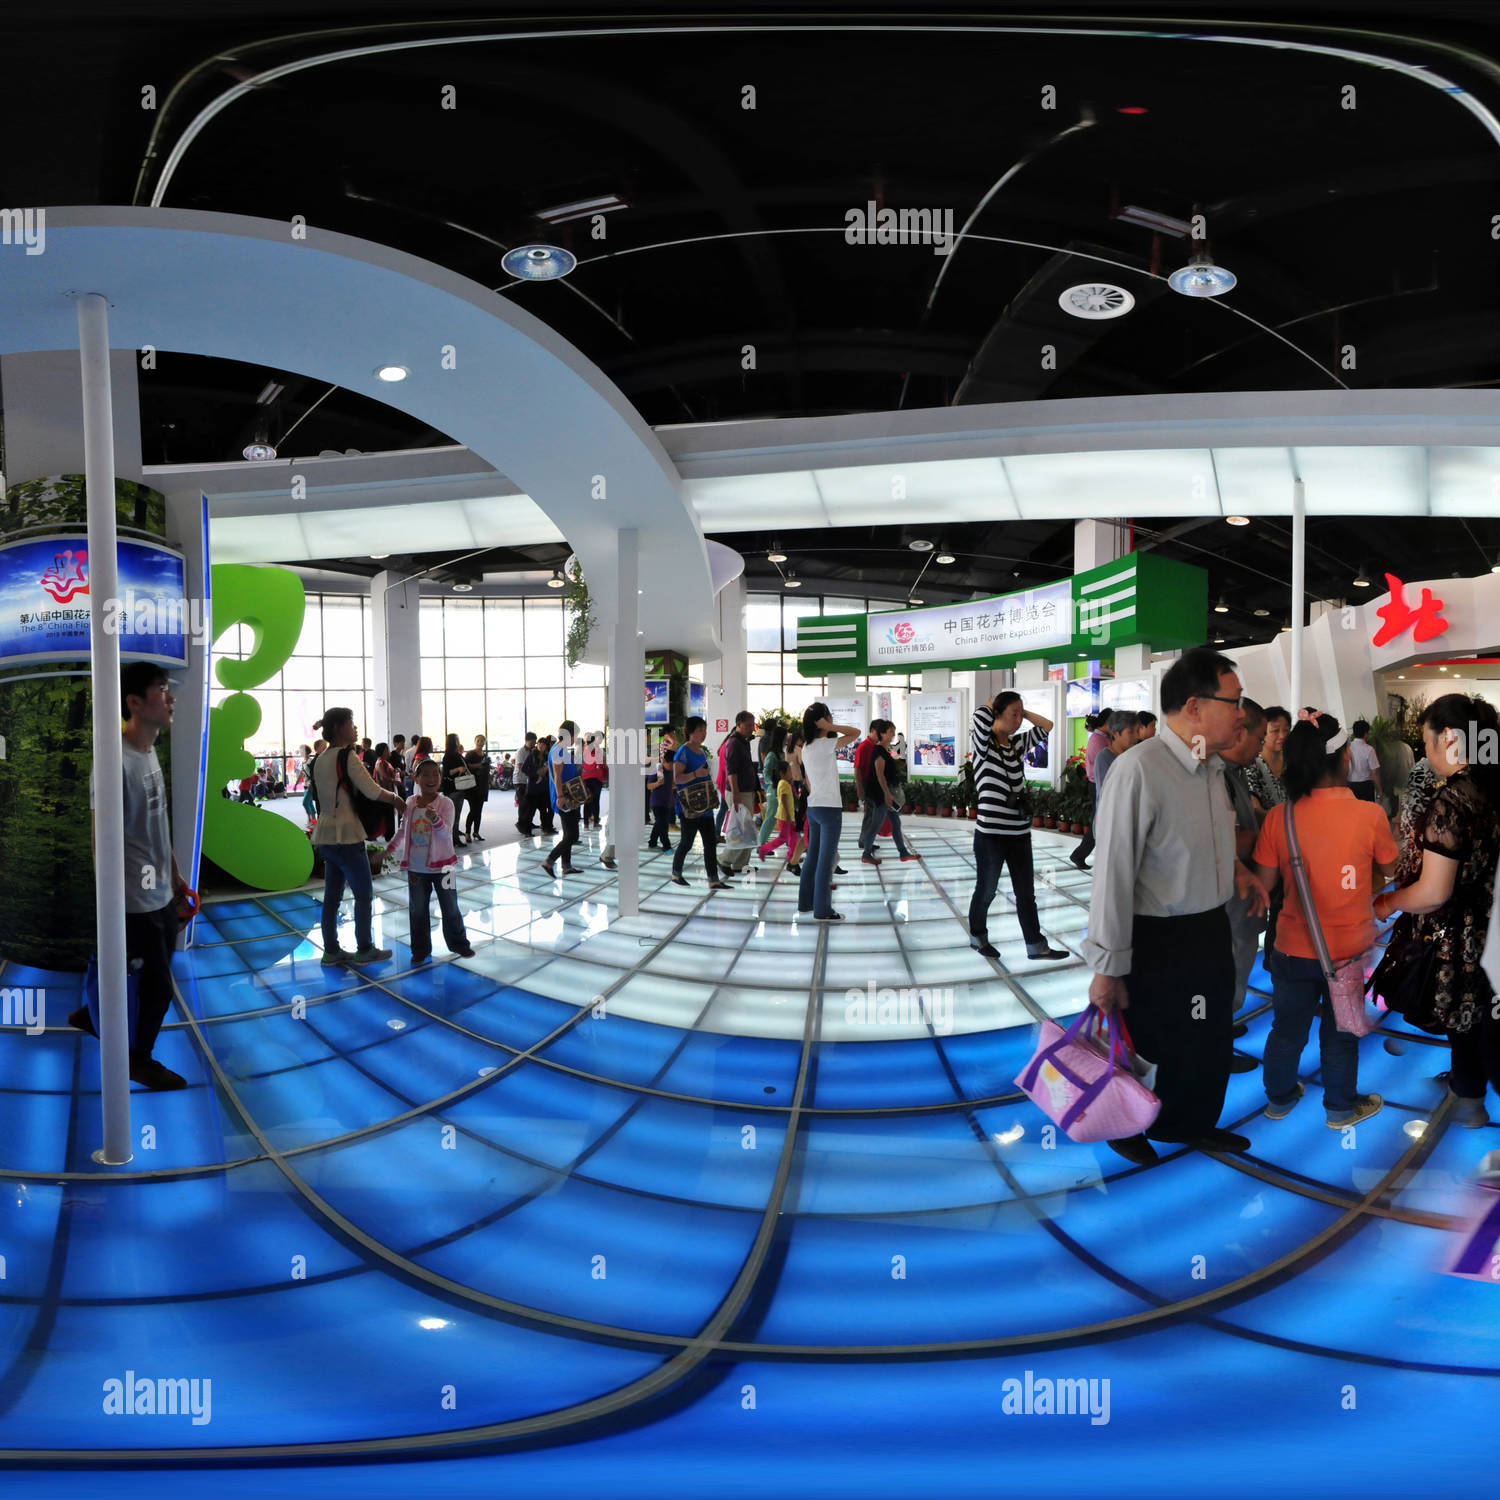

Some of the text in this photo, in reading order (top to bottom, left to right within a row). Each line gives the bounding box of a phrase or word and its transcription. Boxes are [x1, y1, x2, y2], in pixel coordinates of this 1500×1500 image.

[20, 625, 36, 633] The
[48, 622, 73, 630] China
[75, 621, 91, 629] Flo
[944, 600, 1056, 635] 中国花卉博览会
[955, 625, 1051, 646] China Flower Exposition
